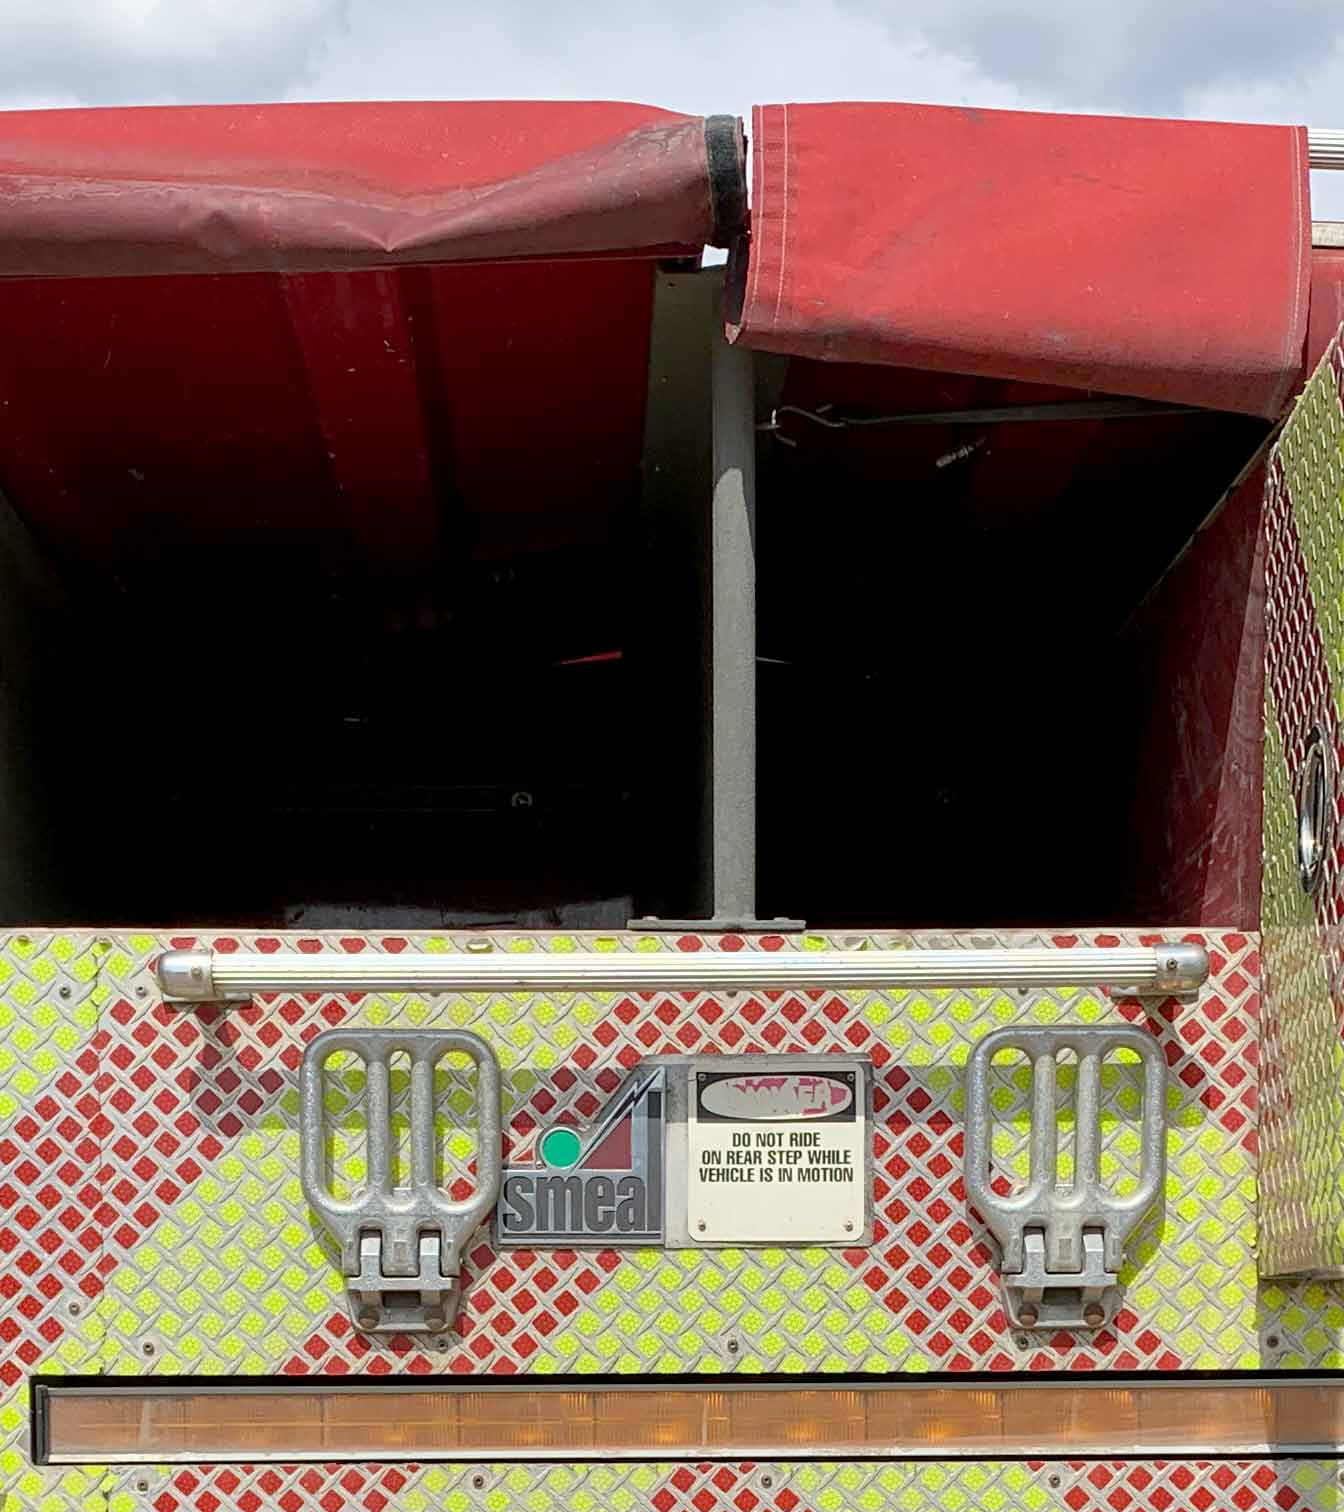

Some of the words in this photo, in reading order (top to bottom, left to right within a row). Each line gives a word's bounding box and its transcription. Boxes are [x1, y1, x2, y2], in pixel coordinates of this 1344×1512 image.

[732, 1132, 751, 1147] DO
[756, 1132, 784, 1147] NOT
[789, 1132, 821, 1147] RIDE
[702, 1150, 721, 1165] ON
[726, 1150, 762, 1165] REAR
[768, 1150, 802, 1165] STEP
[808, 1150, 851, 1164] WHILE
[699, 1167, 755, 1182] VEHICLE
[760, 1167, 773, 1182] IS
[779, 1167, 793, 1182] IN
[798, 1167, 854, 1182] MOTION
